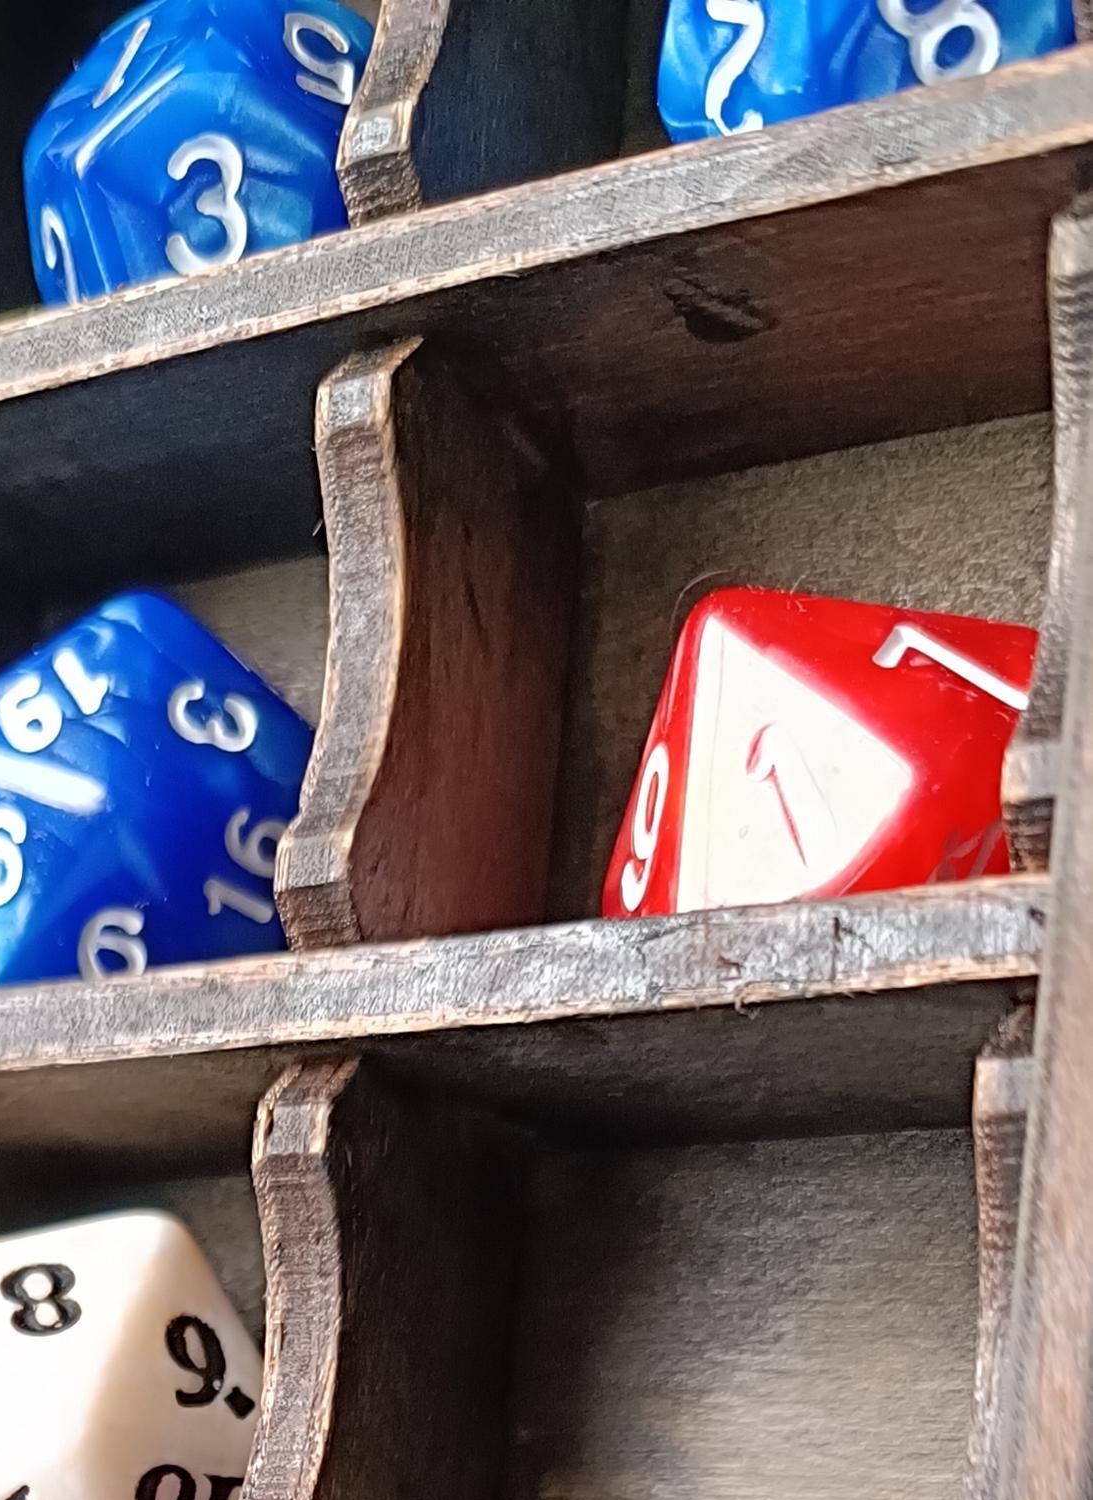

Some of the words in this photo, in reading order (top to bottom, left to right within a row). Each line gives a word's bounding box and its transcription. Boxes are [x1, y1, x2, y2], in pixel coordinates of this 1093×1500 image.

[283, 12, 354, 104] 5
[165, 134, 248, 276] 3
[166, 678, 258, 753] 3
[204, 806, 289, 925] 16
[0, 1263, 82, 1337] 8
